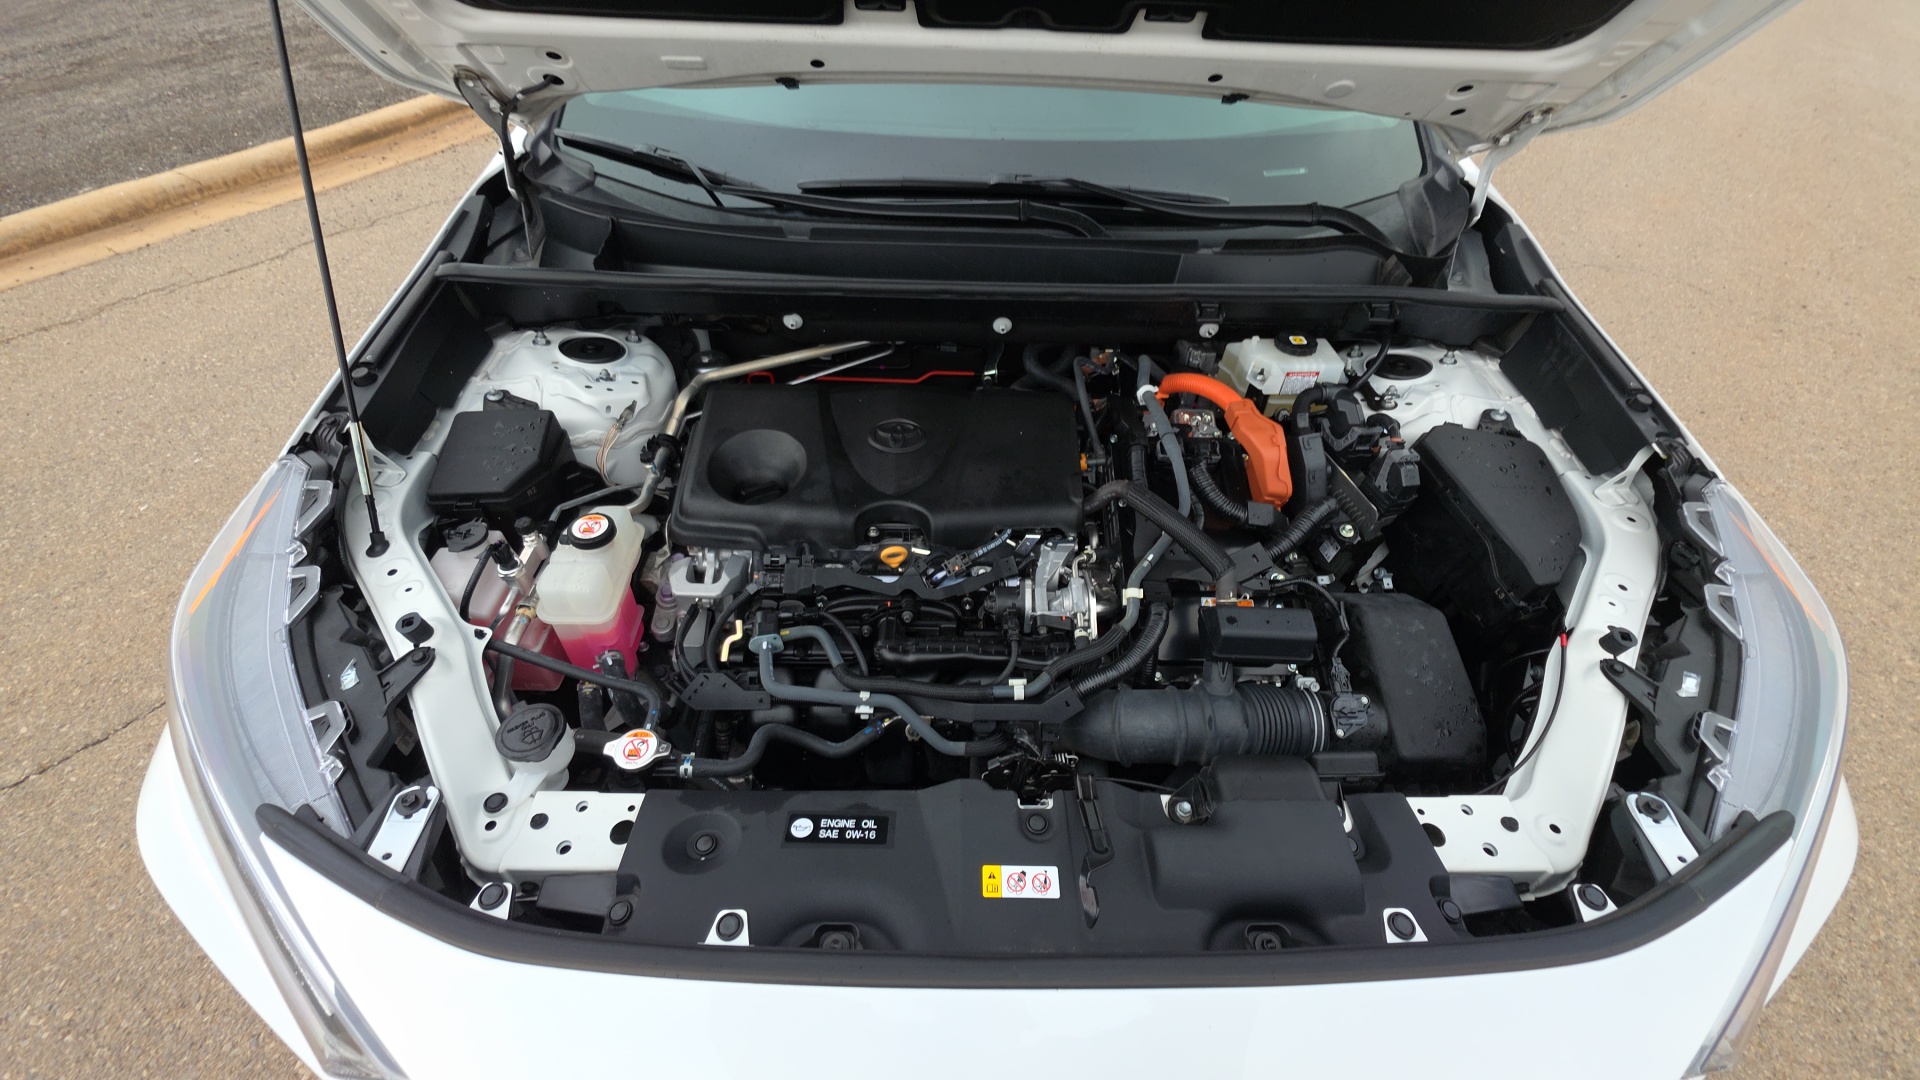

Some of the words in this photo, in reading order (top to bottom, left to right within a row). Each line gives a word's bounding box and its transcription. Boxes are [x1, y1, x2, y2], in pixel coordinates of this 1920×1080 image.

[820, 818, 856, 828] ENGINE
[861, 819, 877, 829] OIL
[818, 829, 839, 839] SAE
[845, 830, 876, 840] 0W-16
